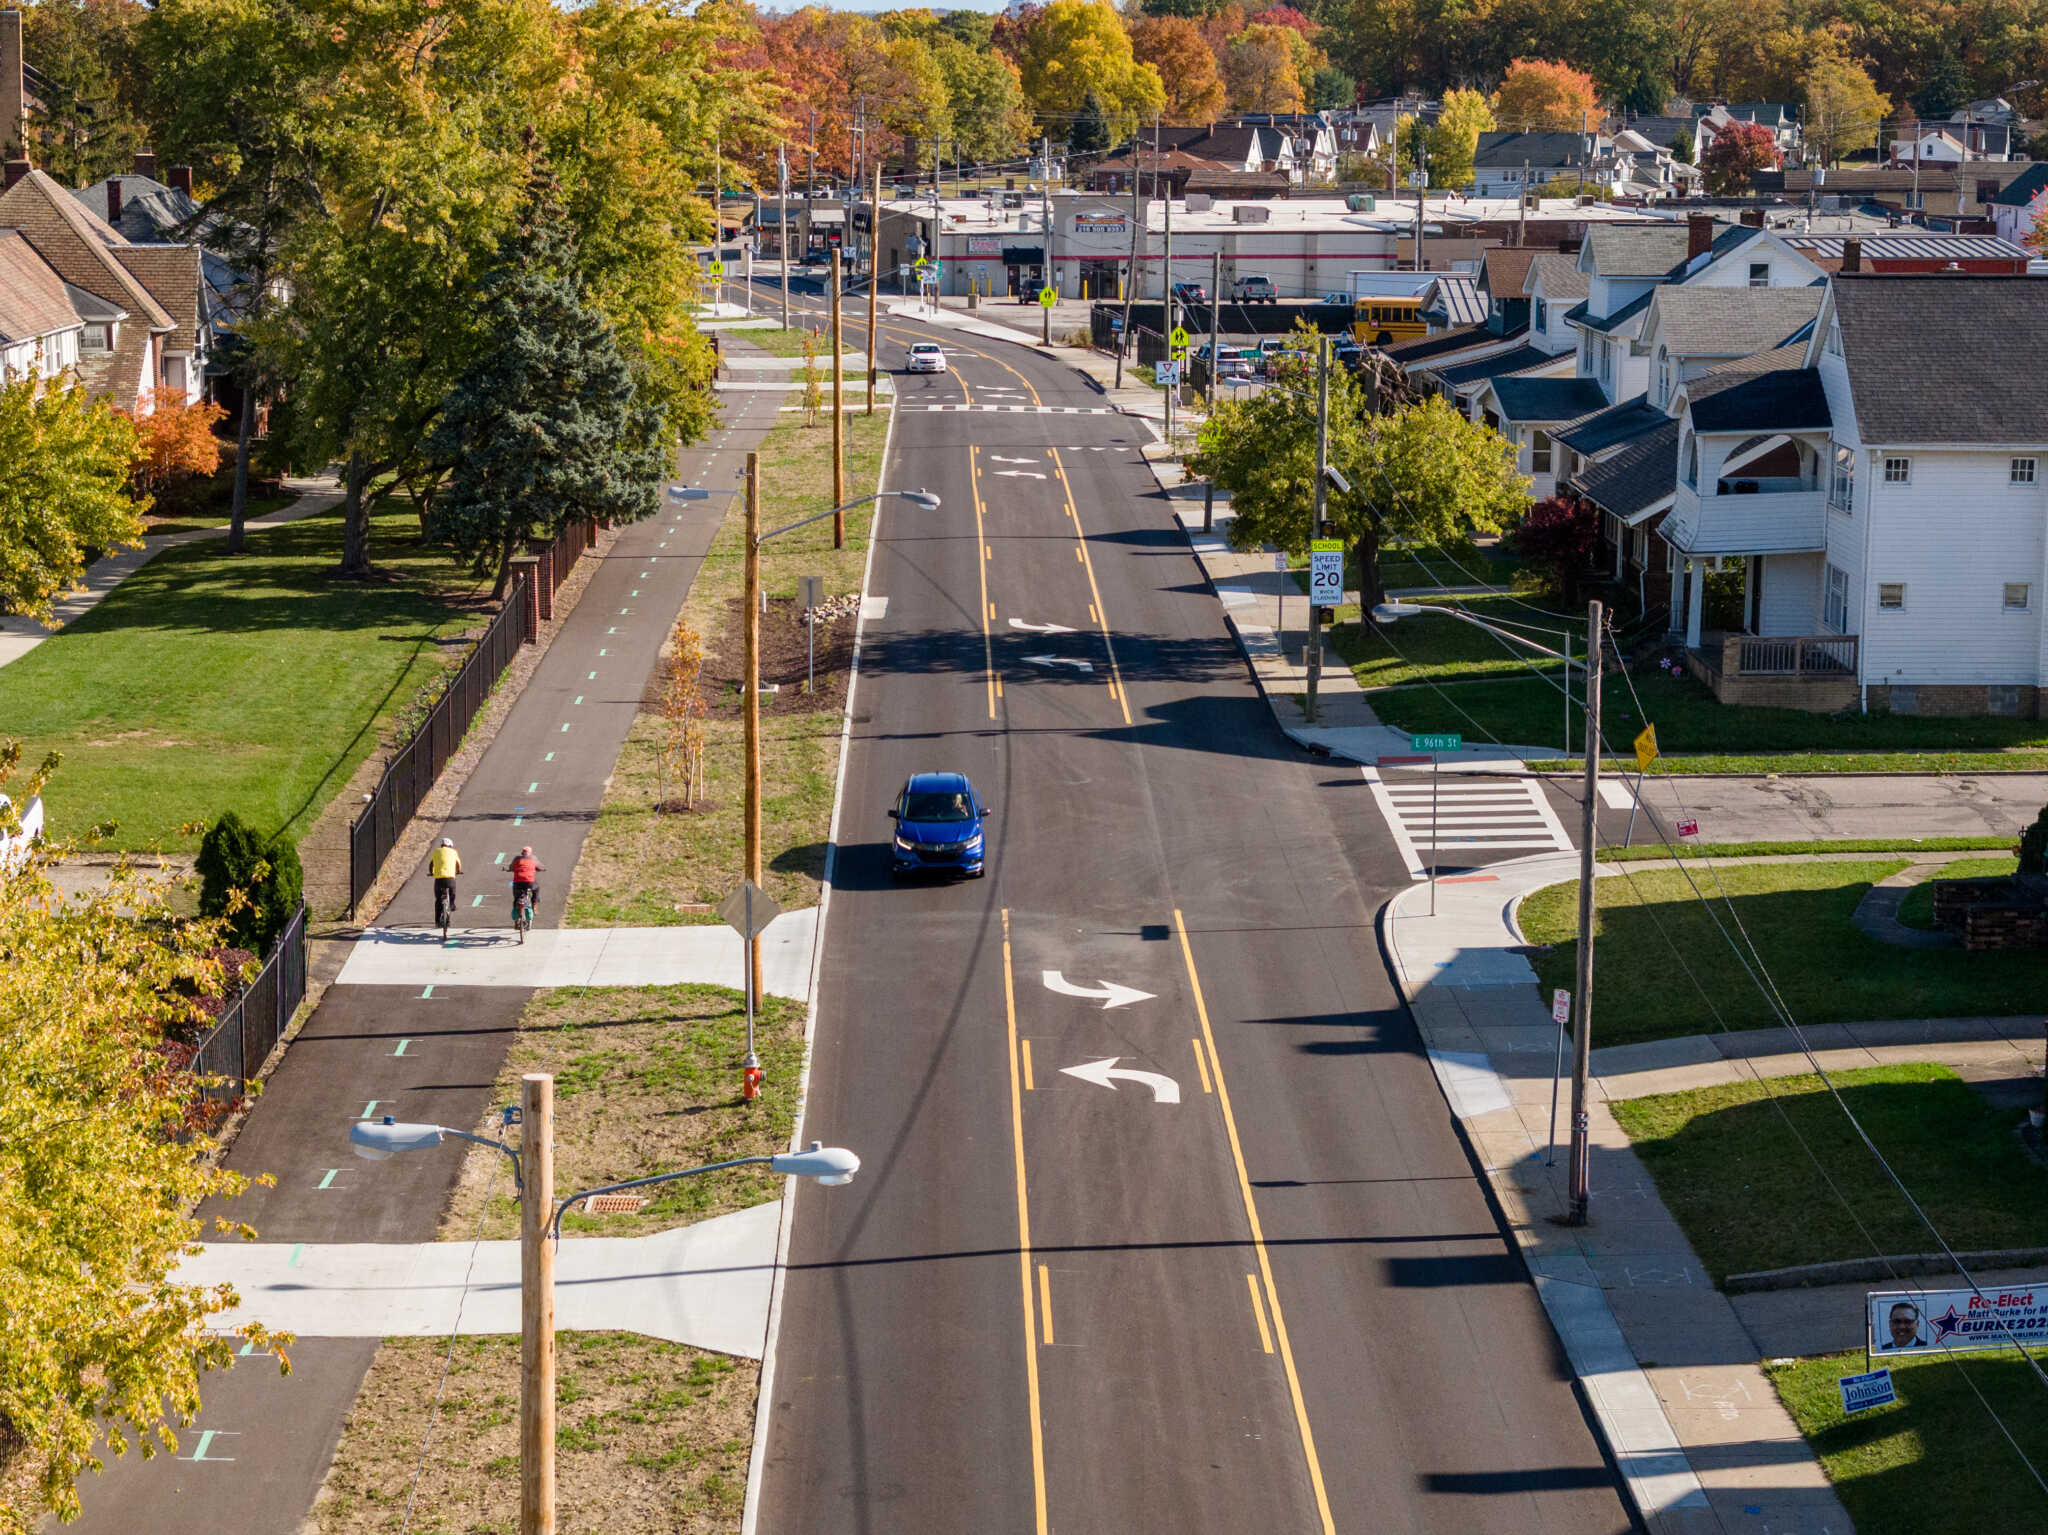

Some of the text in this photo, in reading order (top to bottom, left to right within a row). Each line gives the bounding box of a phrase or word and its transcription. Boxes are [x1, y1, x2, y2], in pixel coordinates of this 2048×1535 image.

[1313, 542, 1341, 550] SCHOOL
[1316, 563, 1337, 571] LIMIT
[1314, 572, 1340, 586] 20
[1415, 736, 1457, 748] E 96th St
[1968, 1293, 2034, 1309] Re-Elect
[1968, 1309, 1989, 1318] Matt
[2023, 1305, 2037, 1315] for
[1961, 1317, 2048, 1332] BURKE202
[1845, 1381, 1892, 1403] Johnson
